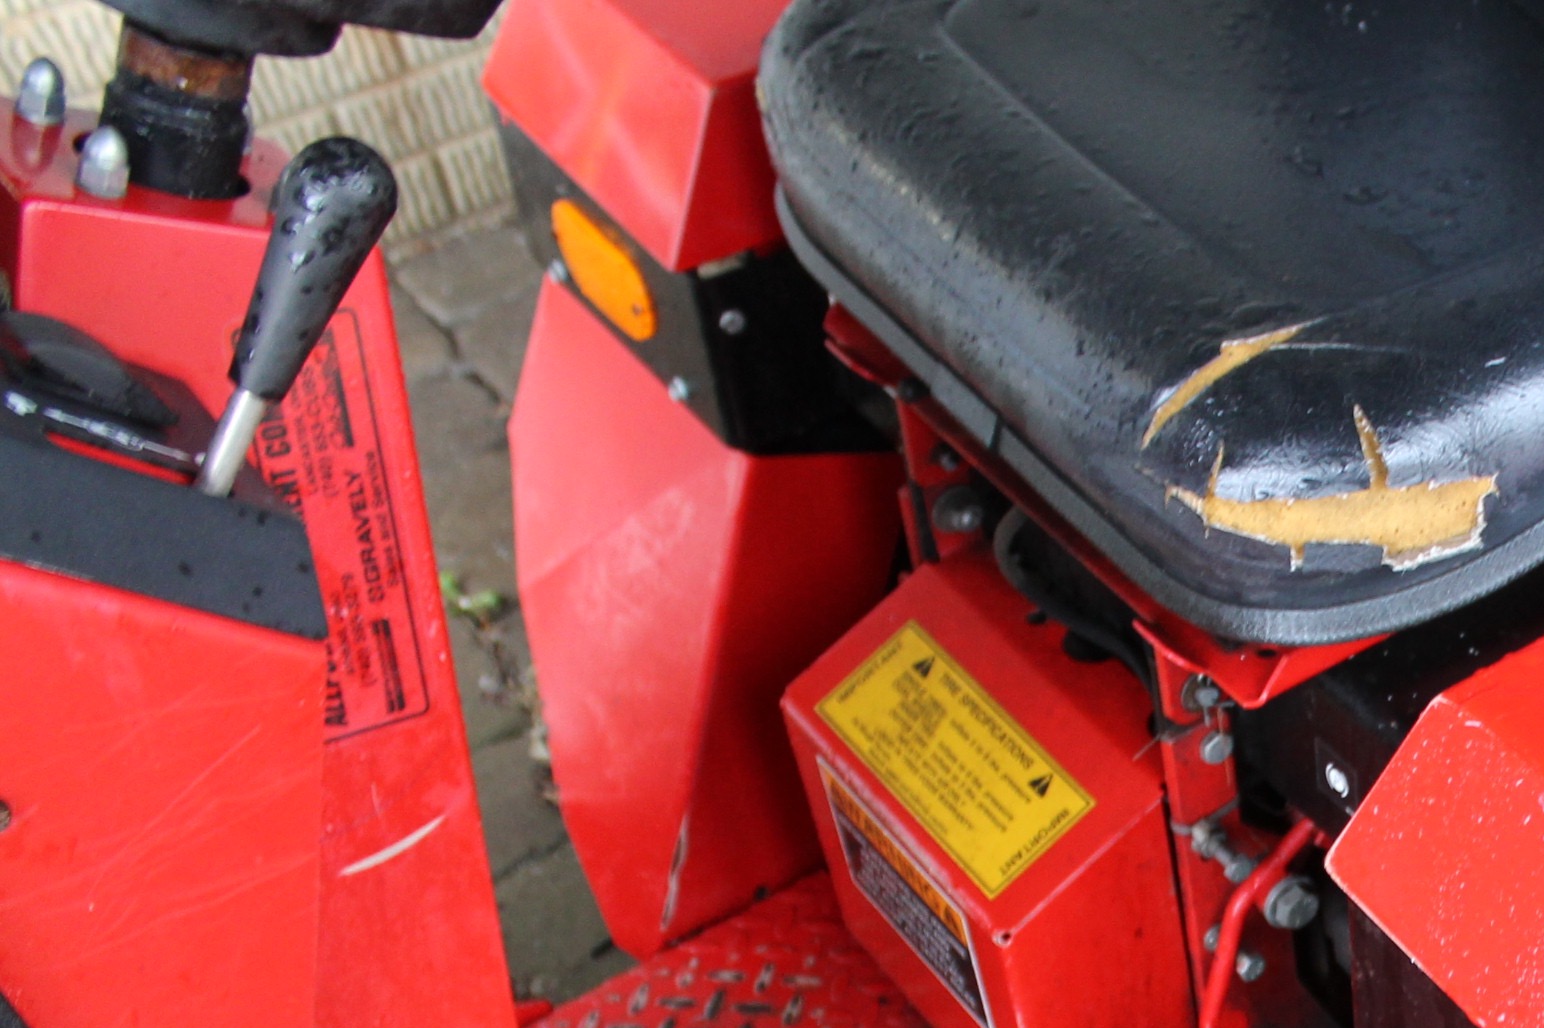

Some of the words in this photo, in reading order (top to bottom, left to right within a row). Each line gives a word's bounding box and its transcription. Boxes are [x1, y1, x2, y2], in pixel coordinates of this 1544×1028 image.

[342, 468, 381, 583] GRAVELY
[960, 695, 1033, 767] SPECIFICATIONS
[1000, 810, 1068, 873] IMPORTANT
